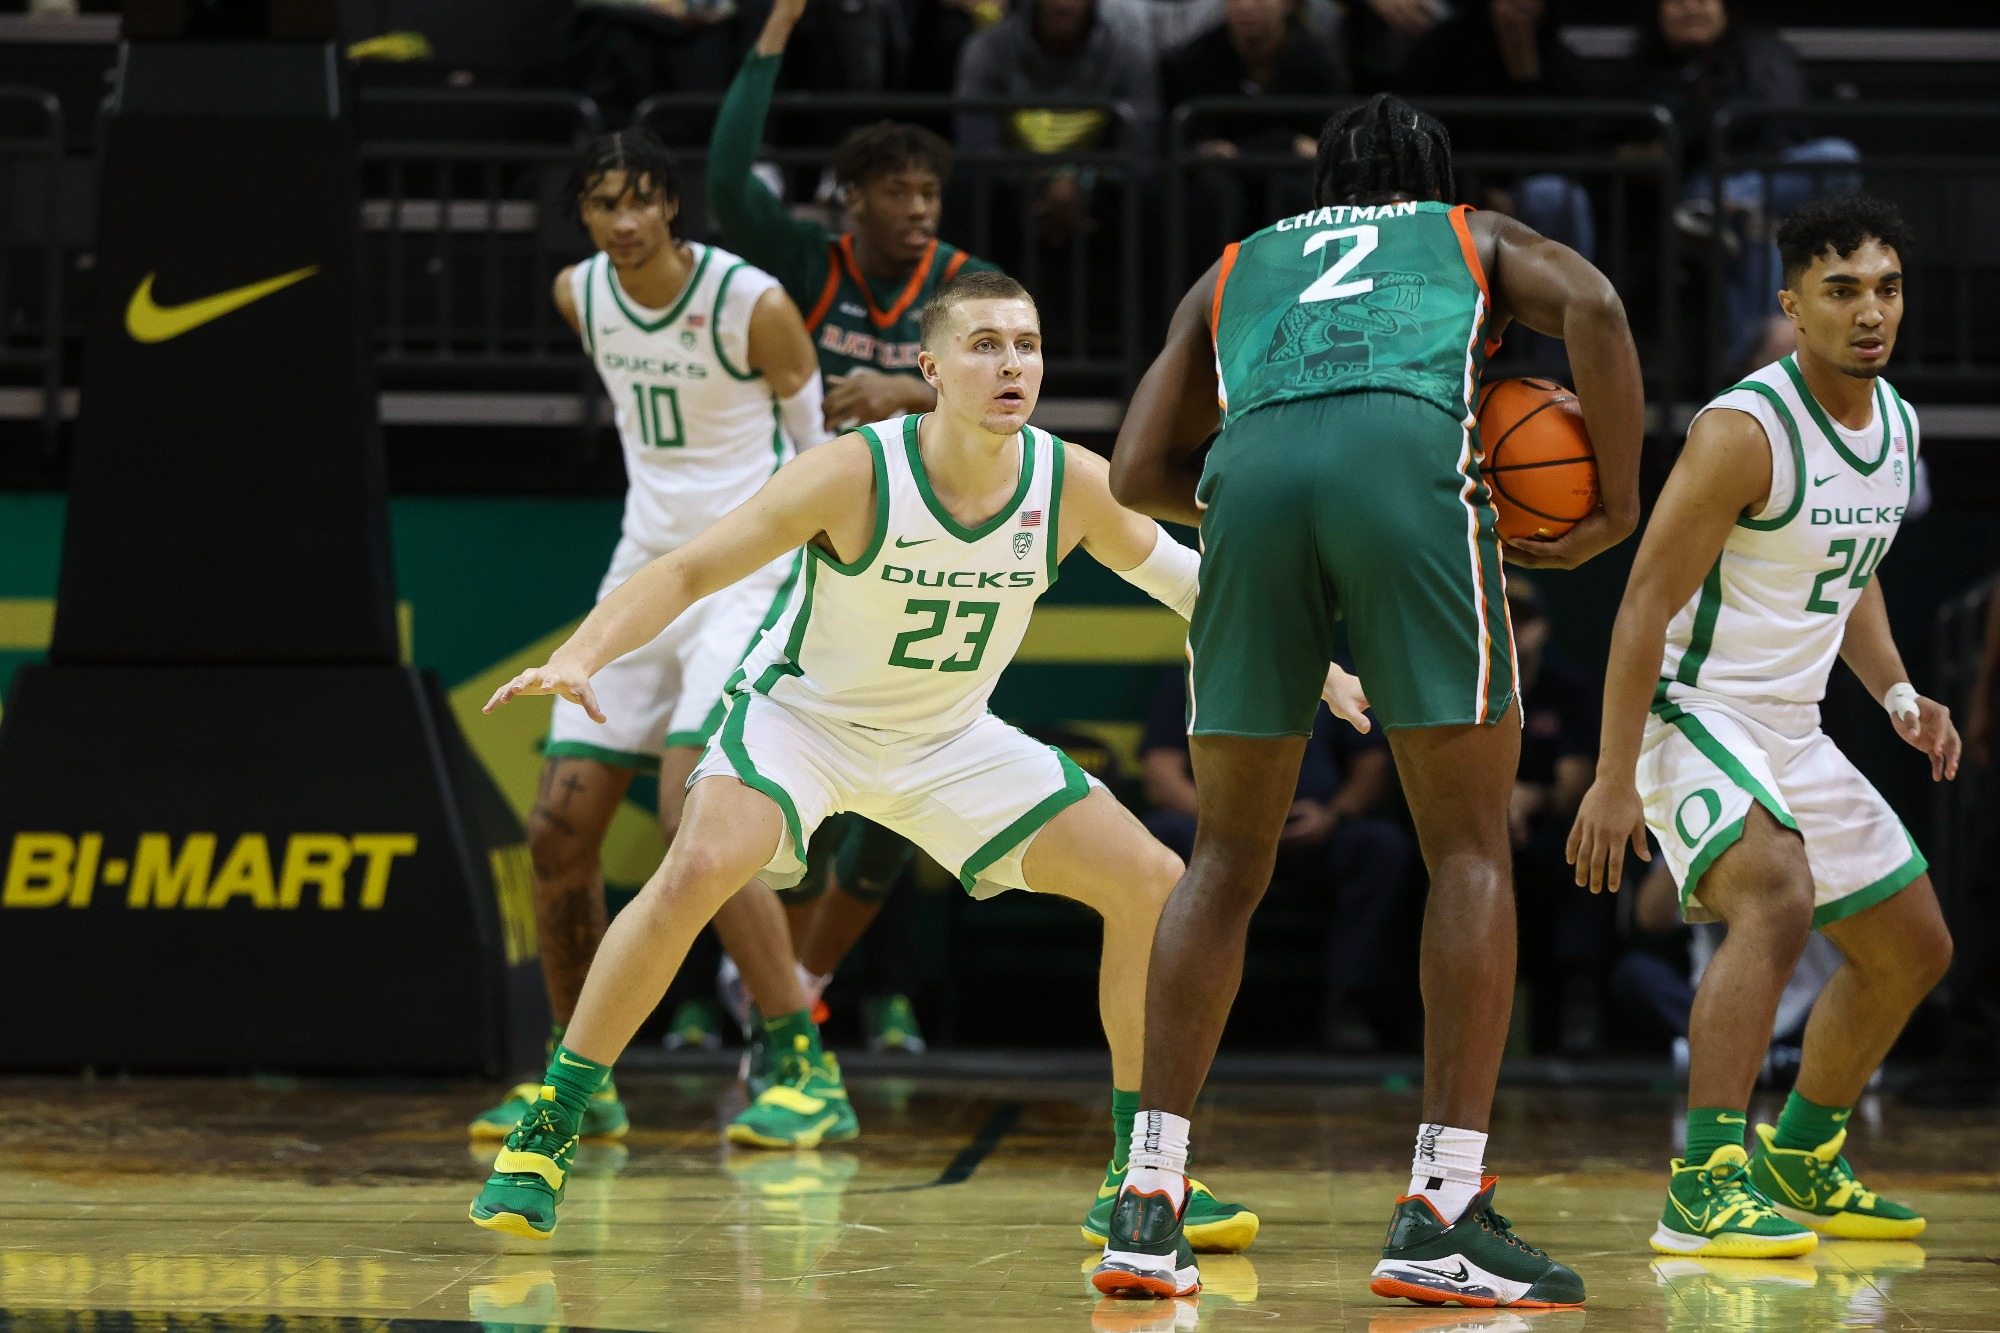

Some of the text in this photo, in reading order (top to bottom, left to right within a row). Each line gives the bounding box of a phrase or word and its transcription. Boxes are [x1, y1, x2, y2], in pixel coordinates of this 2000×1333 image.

[1276, 201, 1417, 232] CHATMAN
[1299, 224, 1379, 303] 2
[604, 353, 707, 378] DUCKS
[632, 384, 685, 447] 10
[1811, 506, 1905, 525] DUCKS
[881, 564, 1036, 588] DUCKS
[1805, 537, 1887, 614] 24
[888, 599, 1000, 672] 23
